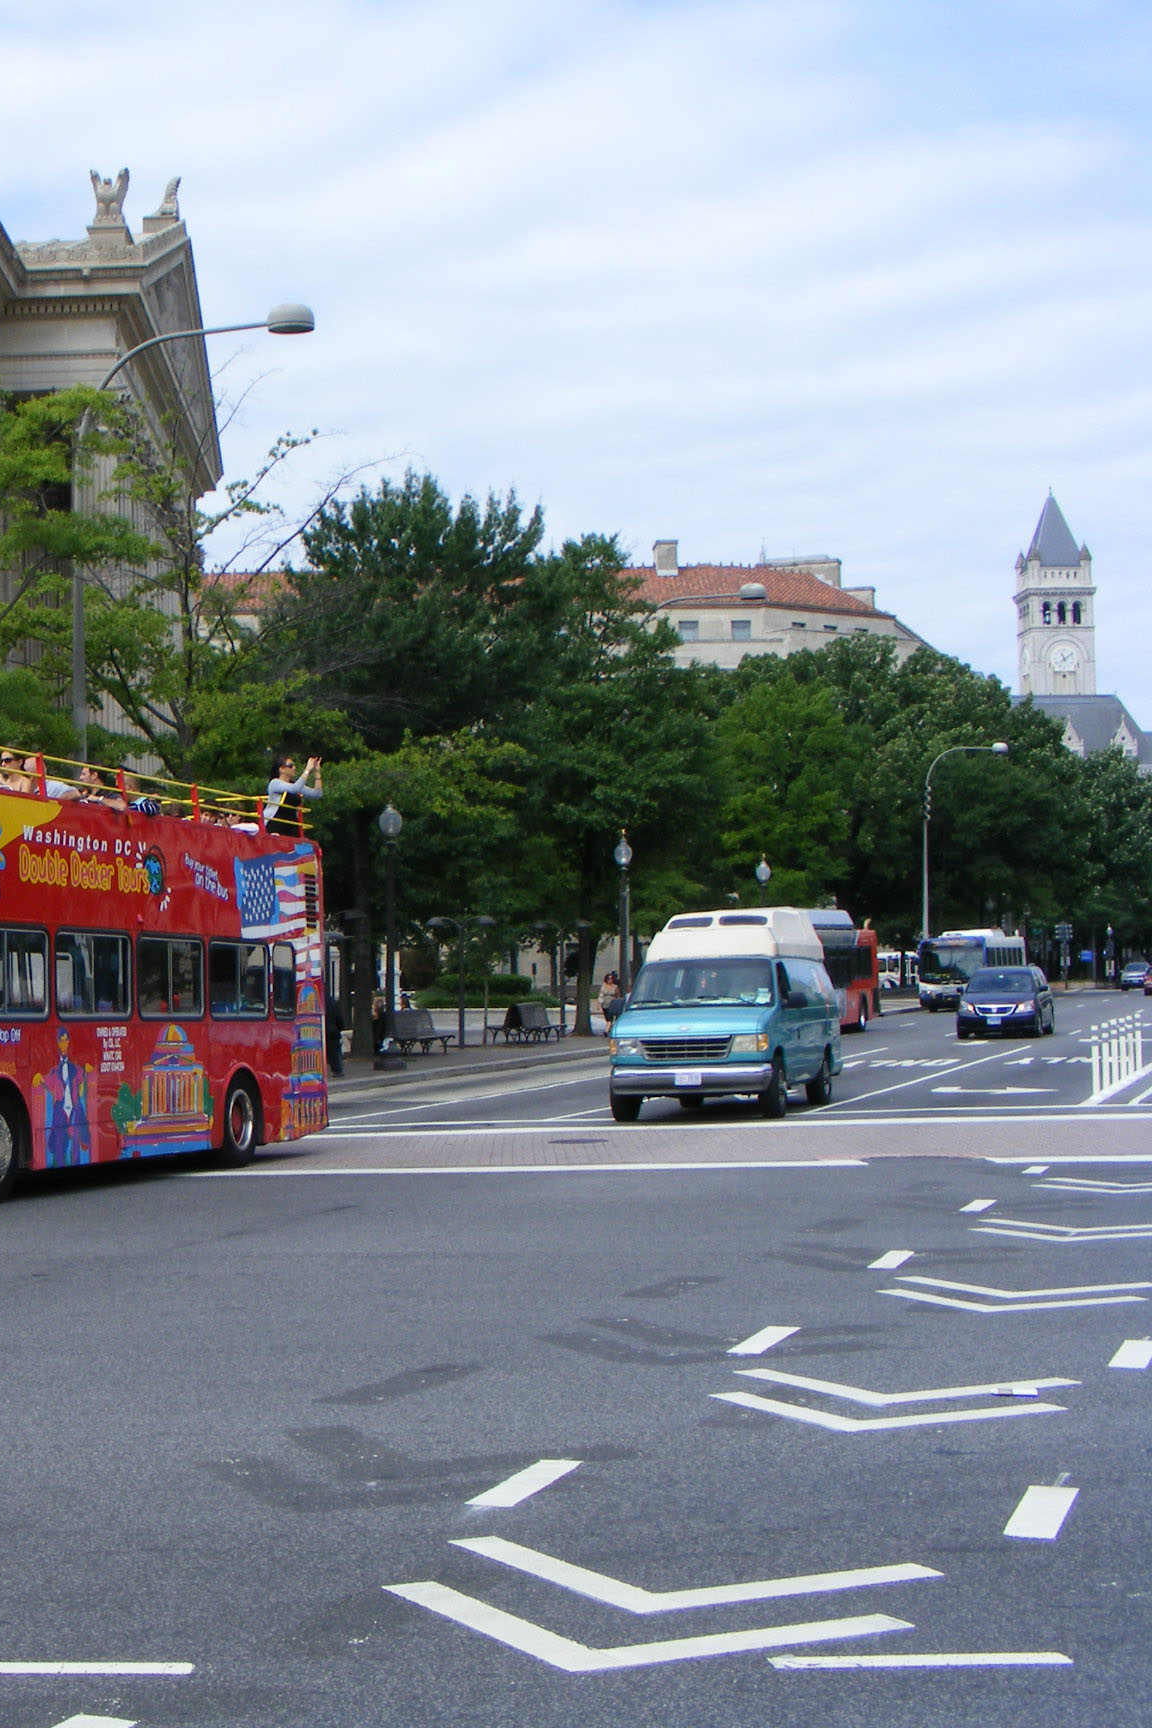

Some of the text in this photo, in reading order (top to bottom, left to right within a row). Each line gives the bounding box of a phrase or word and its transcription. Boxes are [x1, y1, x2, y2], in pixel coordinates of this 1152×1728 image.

[22, 824, 132, 856] Washington DC
[19, 843, 150, 895] Double Decker Tours
[184, 851, 194, 869] Buy
[195, 872, 229, 901] on the bus
[10, 1027, 21, 1042] Off
